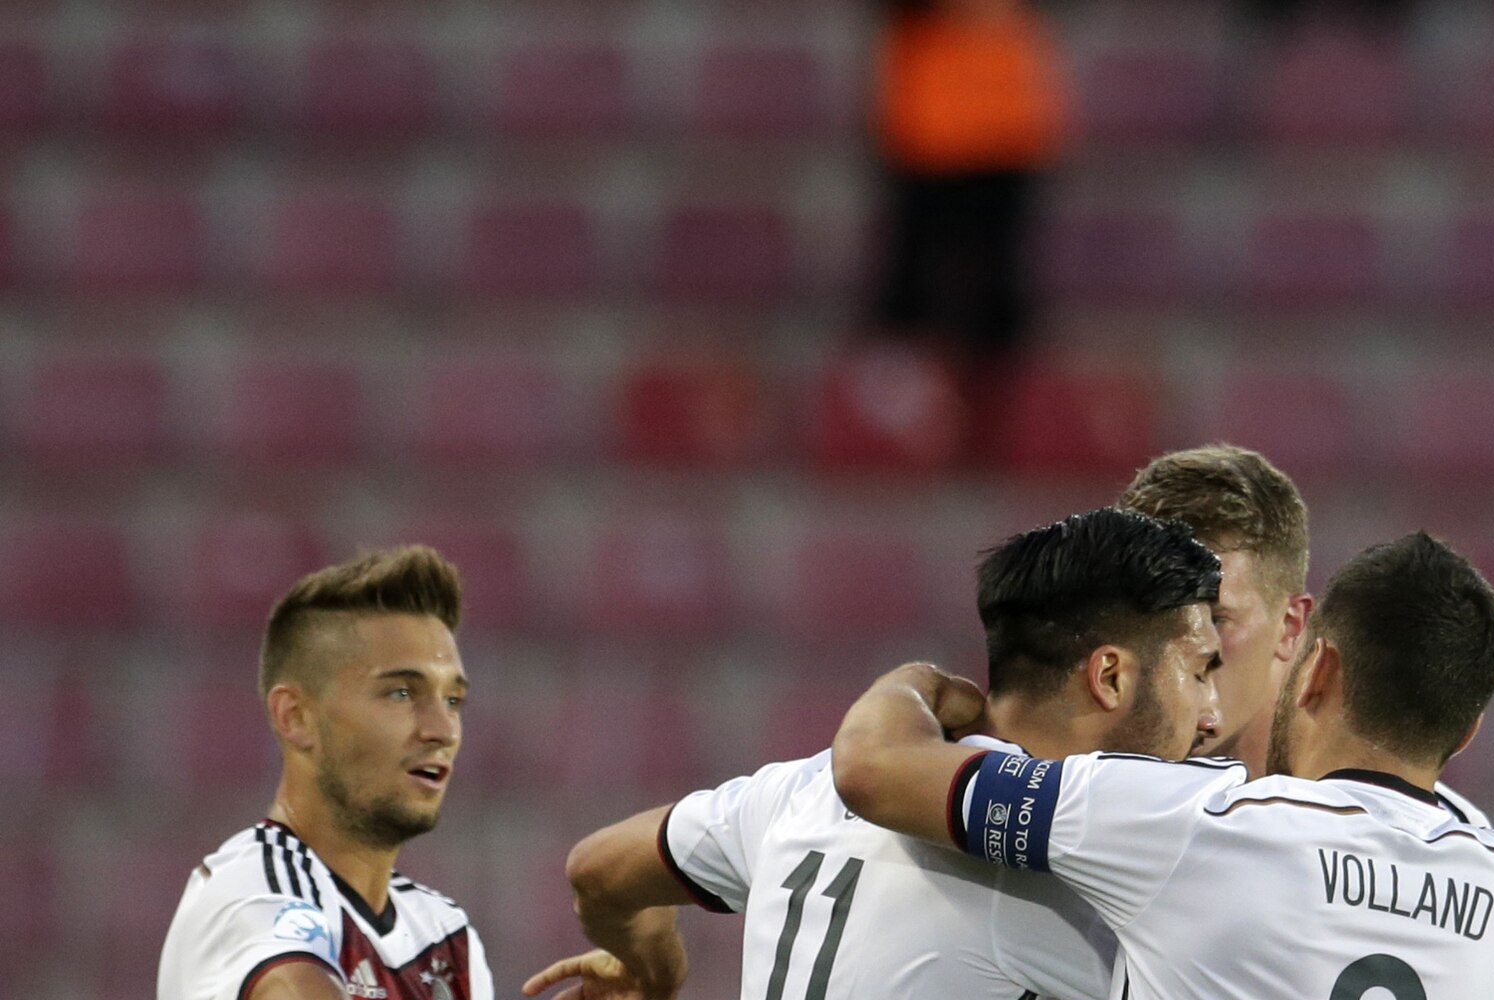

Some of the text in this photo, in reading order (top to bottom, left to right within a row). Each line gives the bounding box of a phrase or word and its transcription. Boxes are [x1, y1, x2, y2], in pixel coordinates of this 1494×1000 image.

[1018, 796, 1036, 825] NO
[1015, 828, 1029, 851] TO
[1317, 848, 1494, 941] VOLLAND
